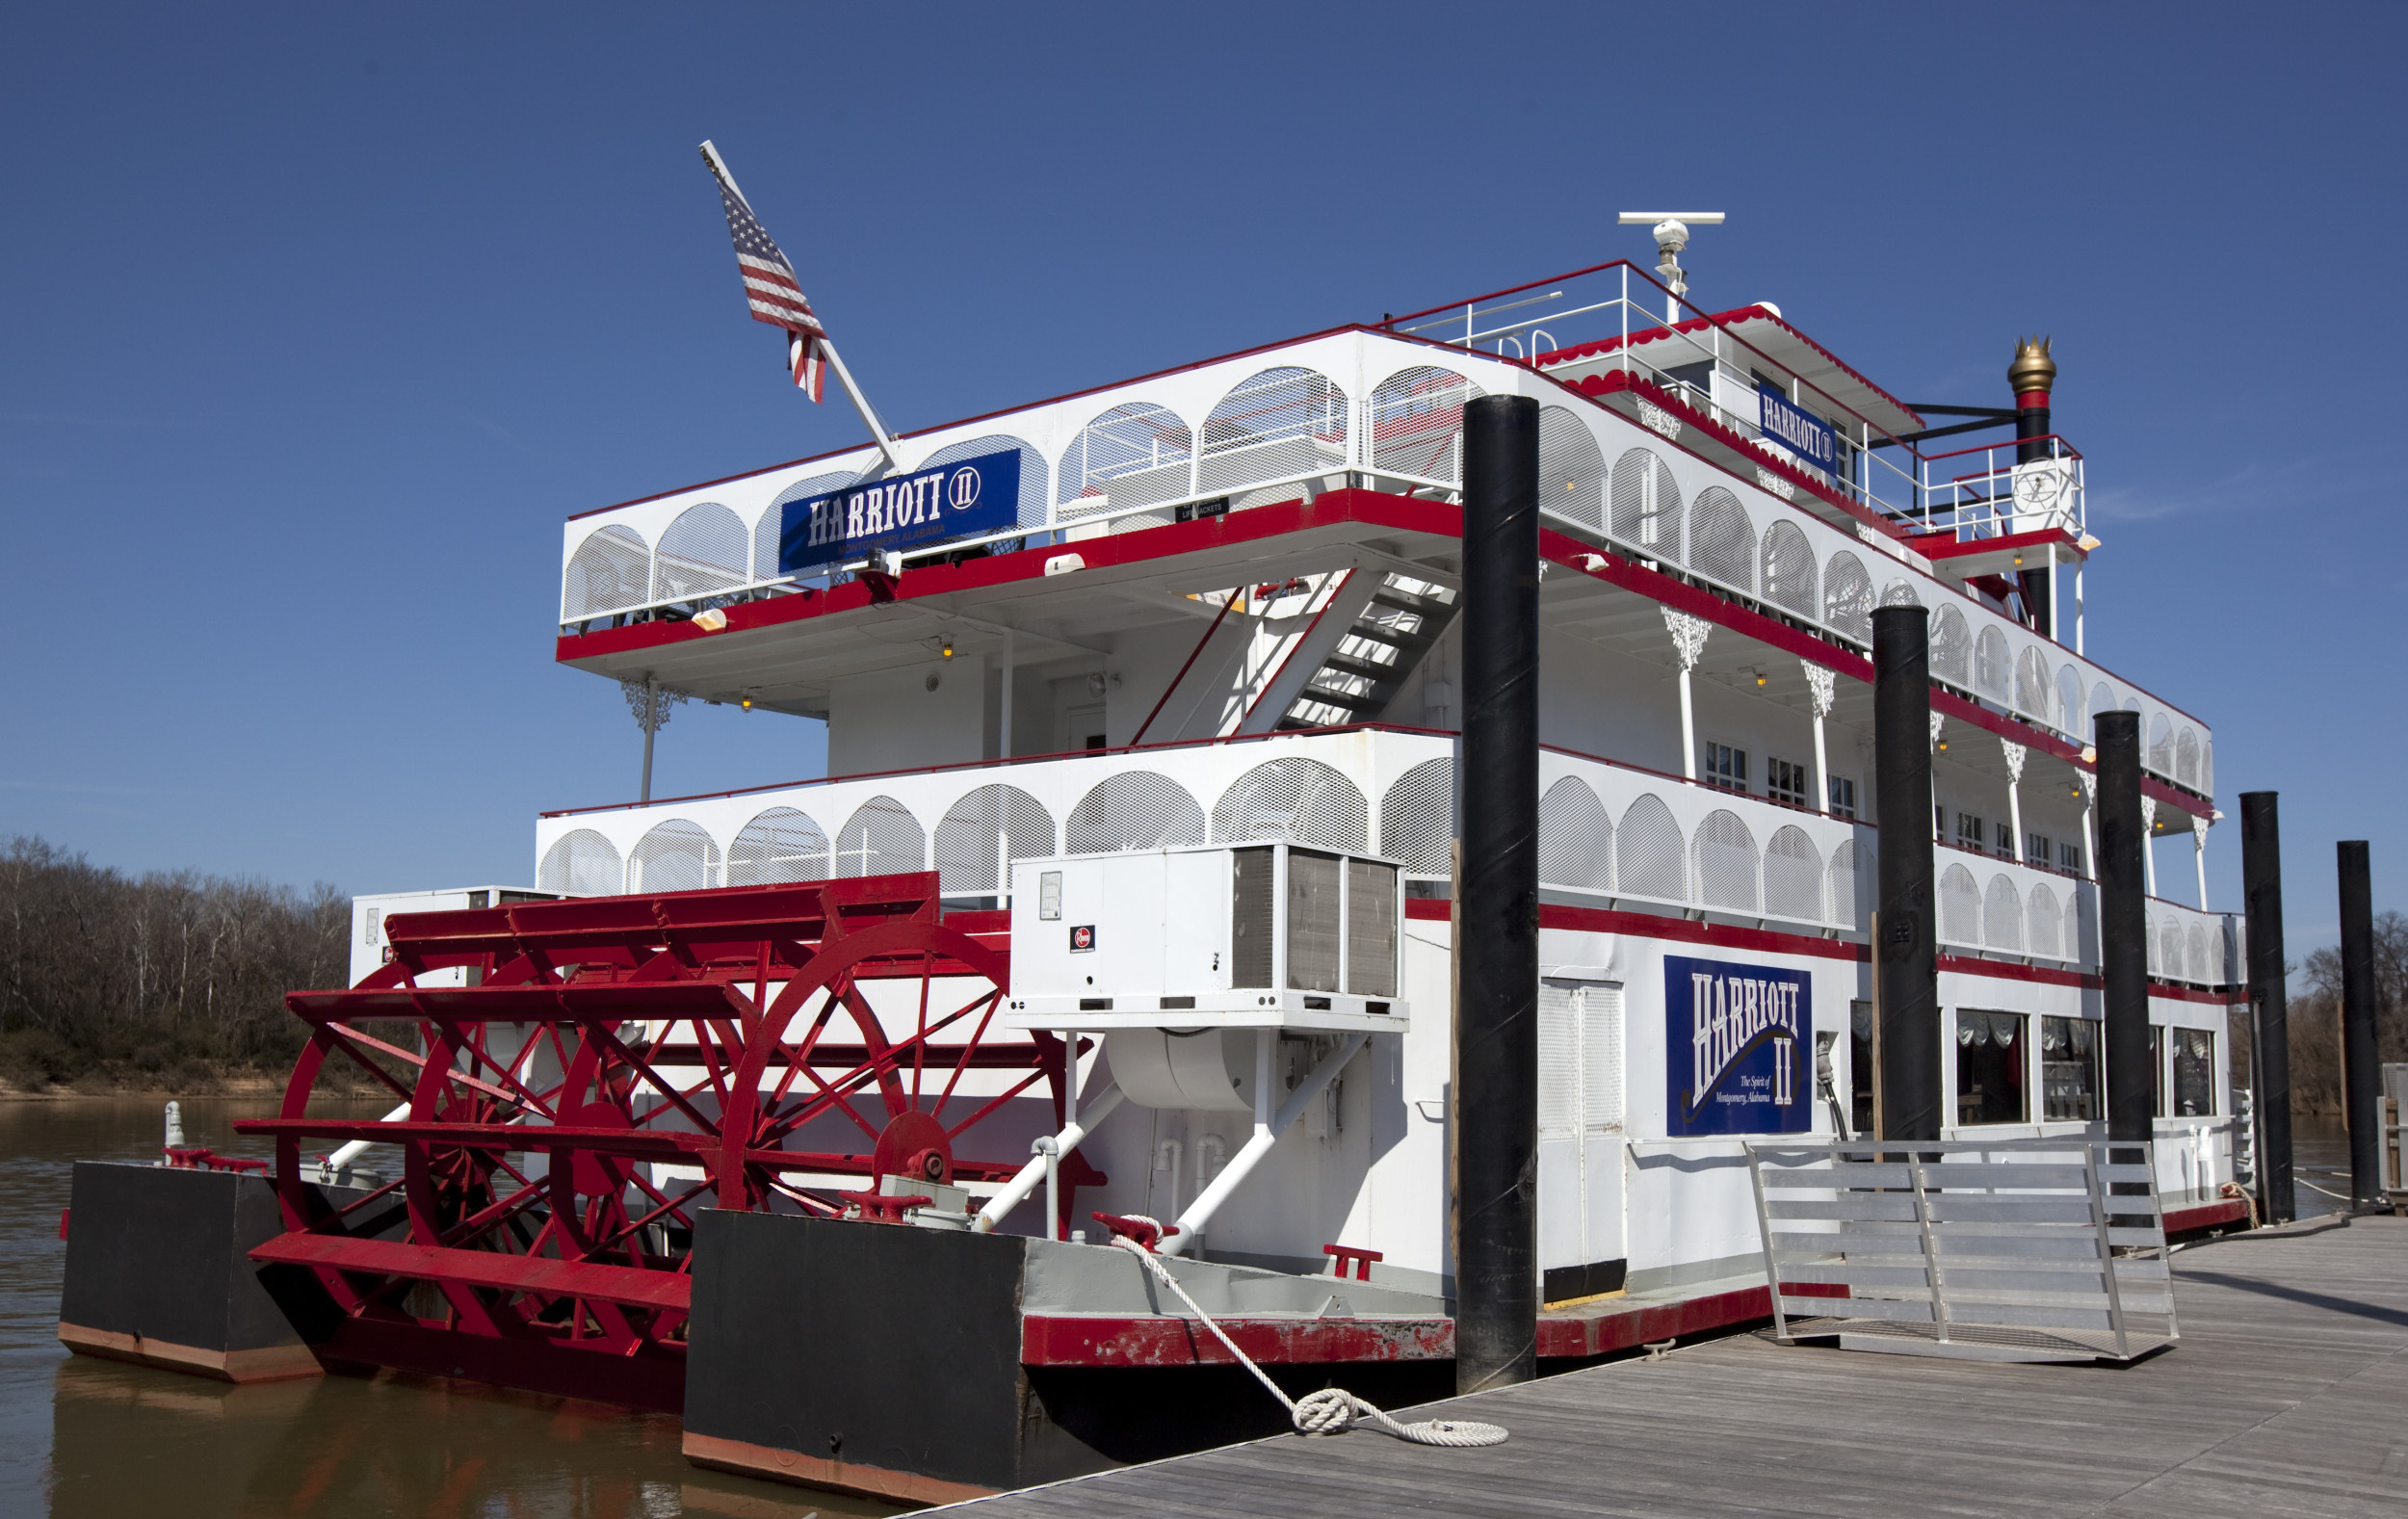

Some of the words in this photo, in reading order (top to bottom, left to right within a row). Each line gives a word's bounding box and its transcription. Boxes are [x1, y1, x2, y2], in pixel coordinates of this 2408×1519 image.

[1763, 394, 1820, 459] HARRIOTT
[807, 472, 944, 547] HARRIOTT
[955, 472, 973, 506] II
[1199, 503, 1222, 514] ACKETS
[903, 524, 946, 542] ALABAMA
[1691, 972, 1798, 1109] HARRIOTT
[1741, 1075, 1750, 1087] The
[1751, 1075, 1765, 1089] Spirit
[1765, 1075, 1771, 1089] of
[1773, 1036, 1793, 1105] II
[1715, 1091, 1747, 1106] Montgomery,
[1747, 1090, 1770, 1103] Alabama
